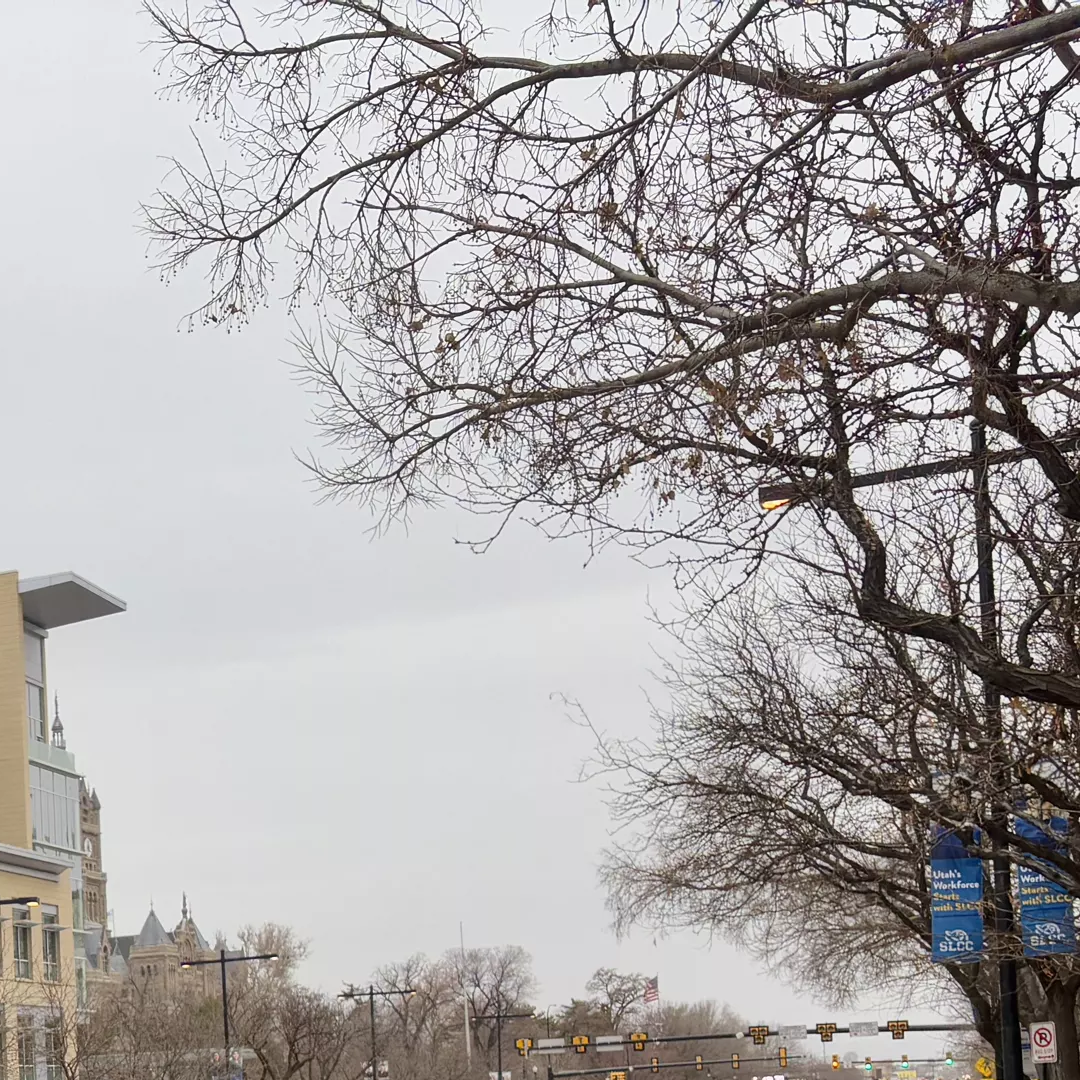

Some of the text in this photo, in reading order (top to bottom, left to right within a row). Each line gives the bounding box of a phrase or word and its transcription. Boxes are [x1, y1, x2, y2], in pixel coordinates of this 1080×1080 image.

[933, 869, 962, 879] Utah's
[933, 881, 980, 890] Workforce
[1021, 886, 1049, 895] Starts
[1022, 895, 1042, 906] with
[939, 941, 974, 952] SLCC
